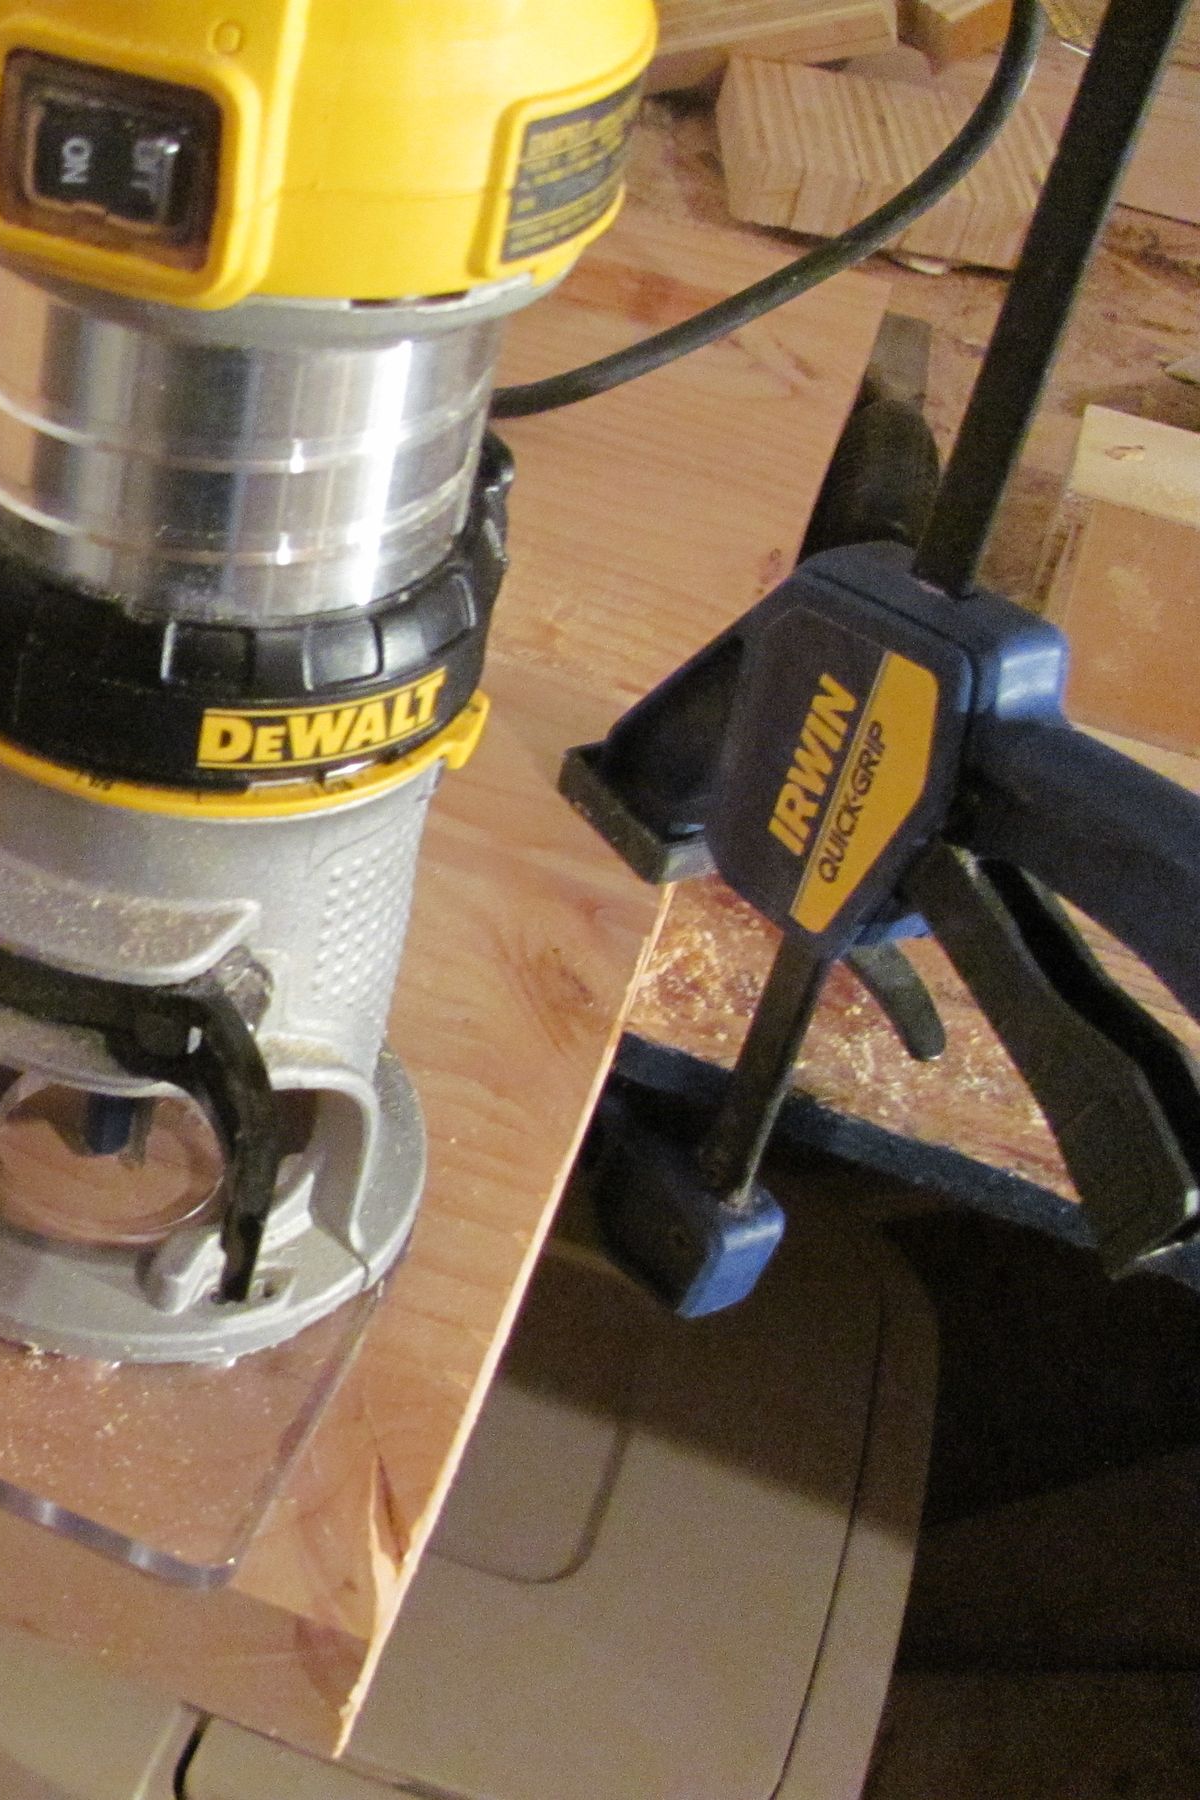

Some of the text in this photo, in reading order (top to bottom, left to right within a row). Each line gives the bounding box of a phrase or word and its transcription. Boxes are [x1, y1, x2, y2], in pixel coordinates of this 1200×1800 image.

[61, 136, 92, 184] ON
[198, 671, 443, 764] DEWALT
[768, 672, 858, 857] IRWIN
[818, 719, 885, 884] QUICK-GRIP
